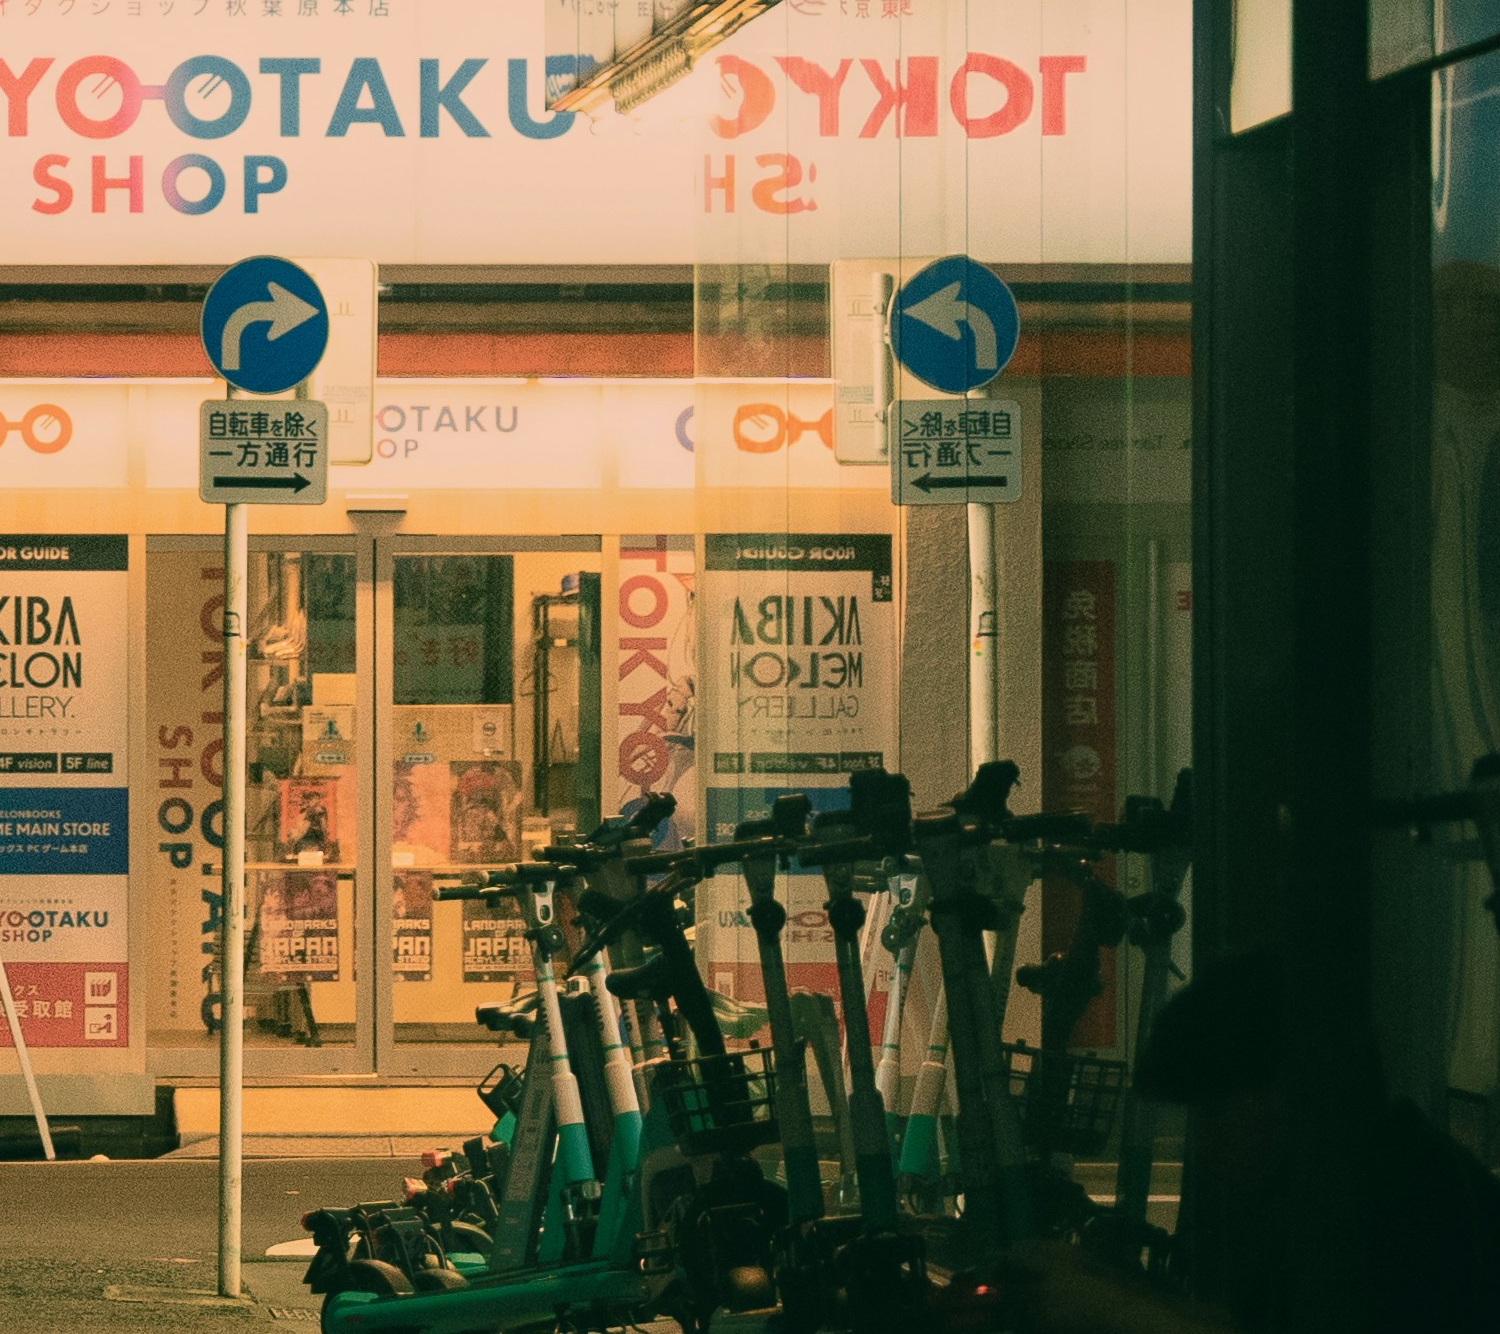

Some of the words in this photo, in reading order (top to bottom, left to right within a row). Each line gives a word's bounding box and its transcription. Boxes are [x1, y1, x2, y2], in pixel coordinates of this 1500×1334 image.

[31, 153, 290, 216] SHOP
[208, 411, 318, 438] 自転車を除く
[376, 405, 519, 433] OTAKU
[208, 441, 318, 468] 一方通行
[20, 547, 70, 560] GUIDE
[618, 535, 669, 786] TOKYO
[17, 756, 52, 768] vision
[66, 756, 83, 768] 5F
[158, 724, 194, 870] SHOP
[16, 822, 60, 836] MAIN
[63, 822, 110, 836] STORE
[28, 910, 110, 928] OTAKU
[1, 930, 53, 943] SHOP
